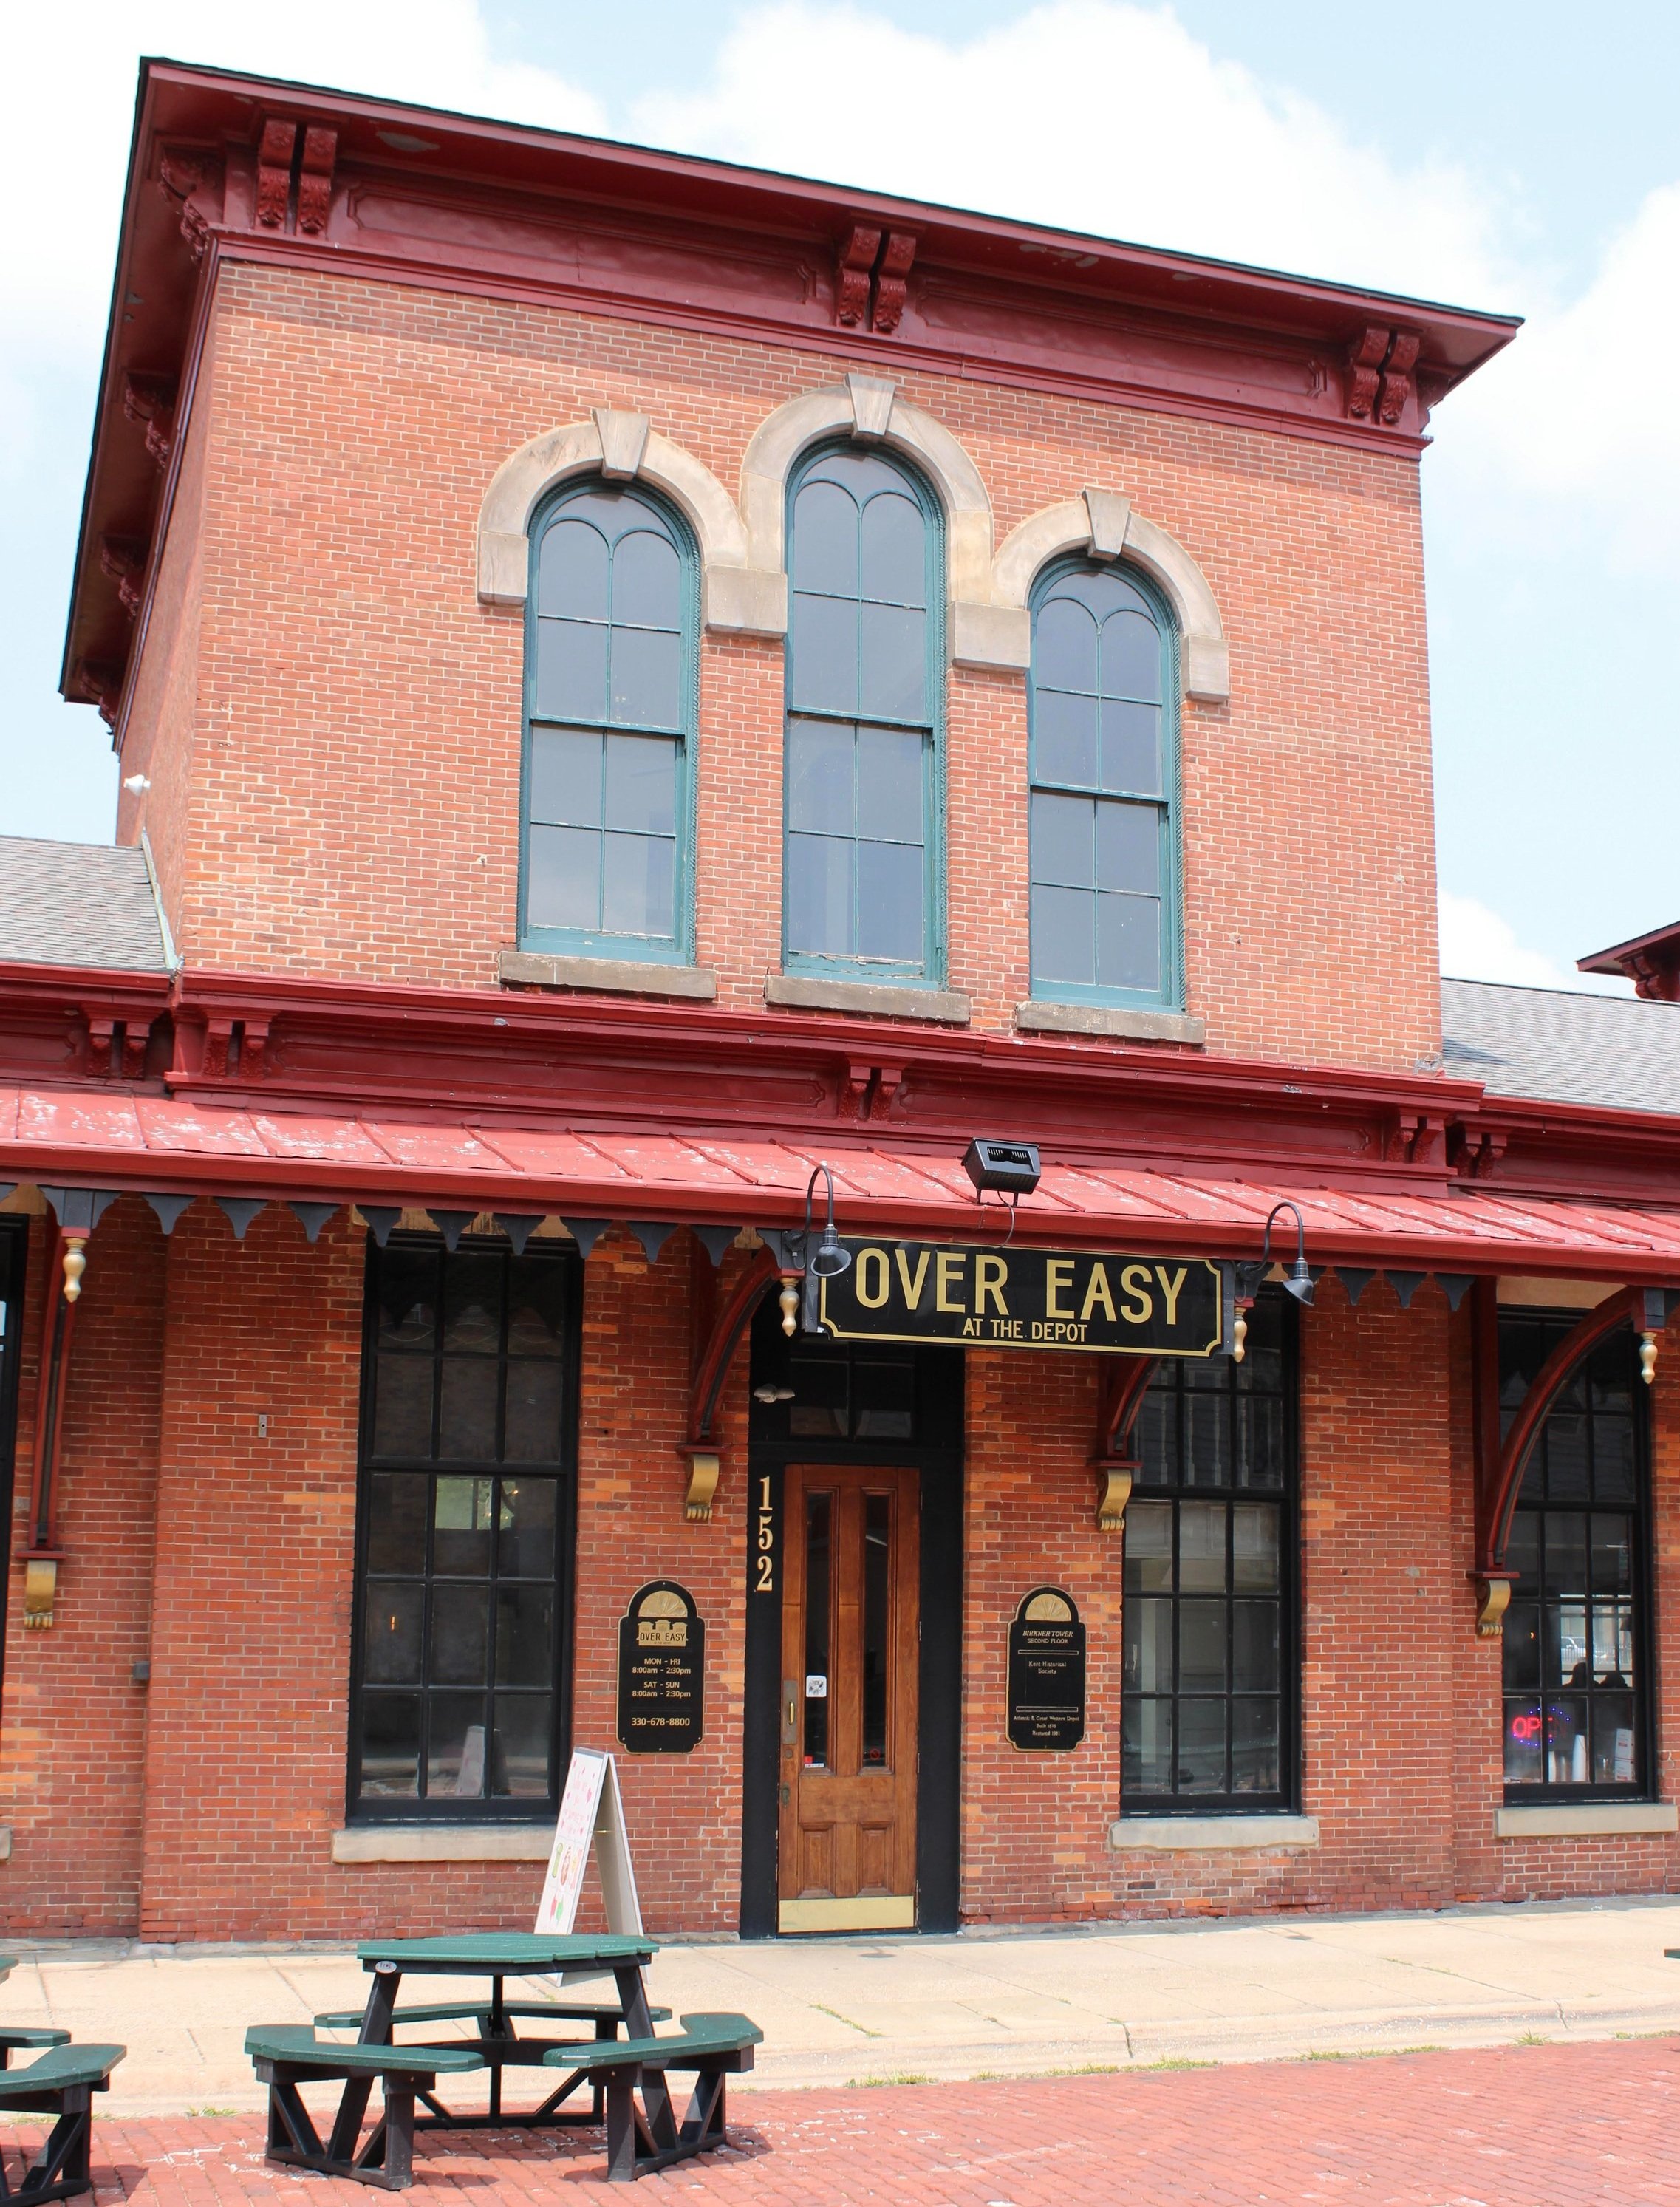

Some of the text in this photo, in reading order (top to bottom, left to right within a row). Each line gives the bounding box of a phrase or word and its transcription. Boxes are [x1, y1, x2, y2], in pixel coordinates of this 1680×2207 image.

[856, 1247, 1189, 1325] OVER EASY
[962, 1317, 1088, 1343] AT THE DEPOT
[756, 1476, 774, 1592] 152
[640, 1632, 686, 1642] OVER EASY
[666, 1667, 692, 1676] 2:30pm
[666, 1690, 691, 1699] 2:30pm
[631, 1717, 691, 1726] 330-678-8800
